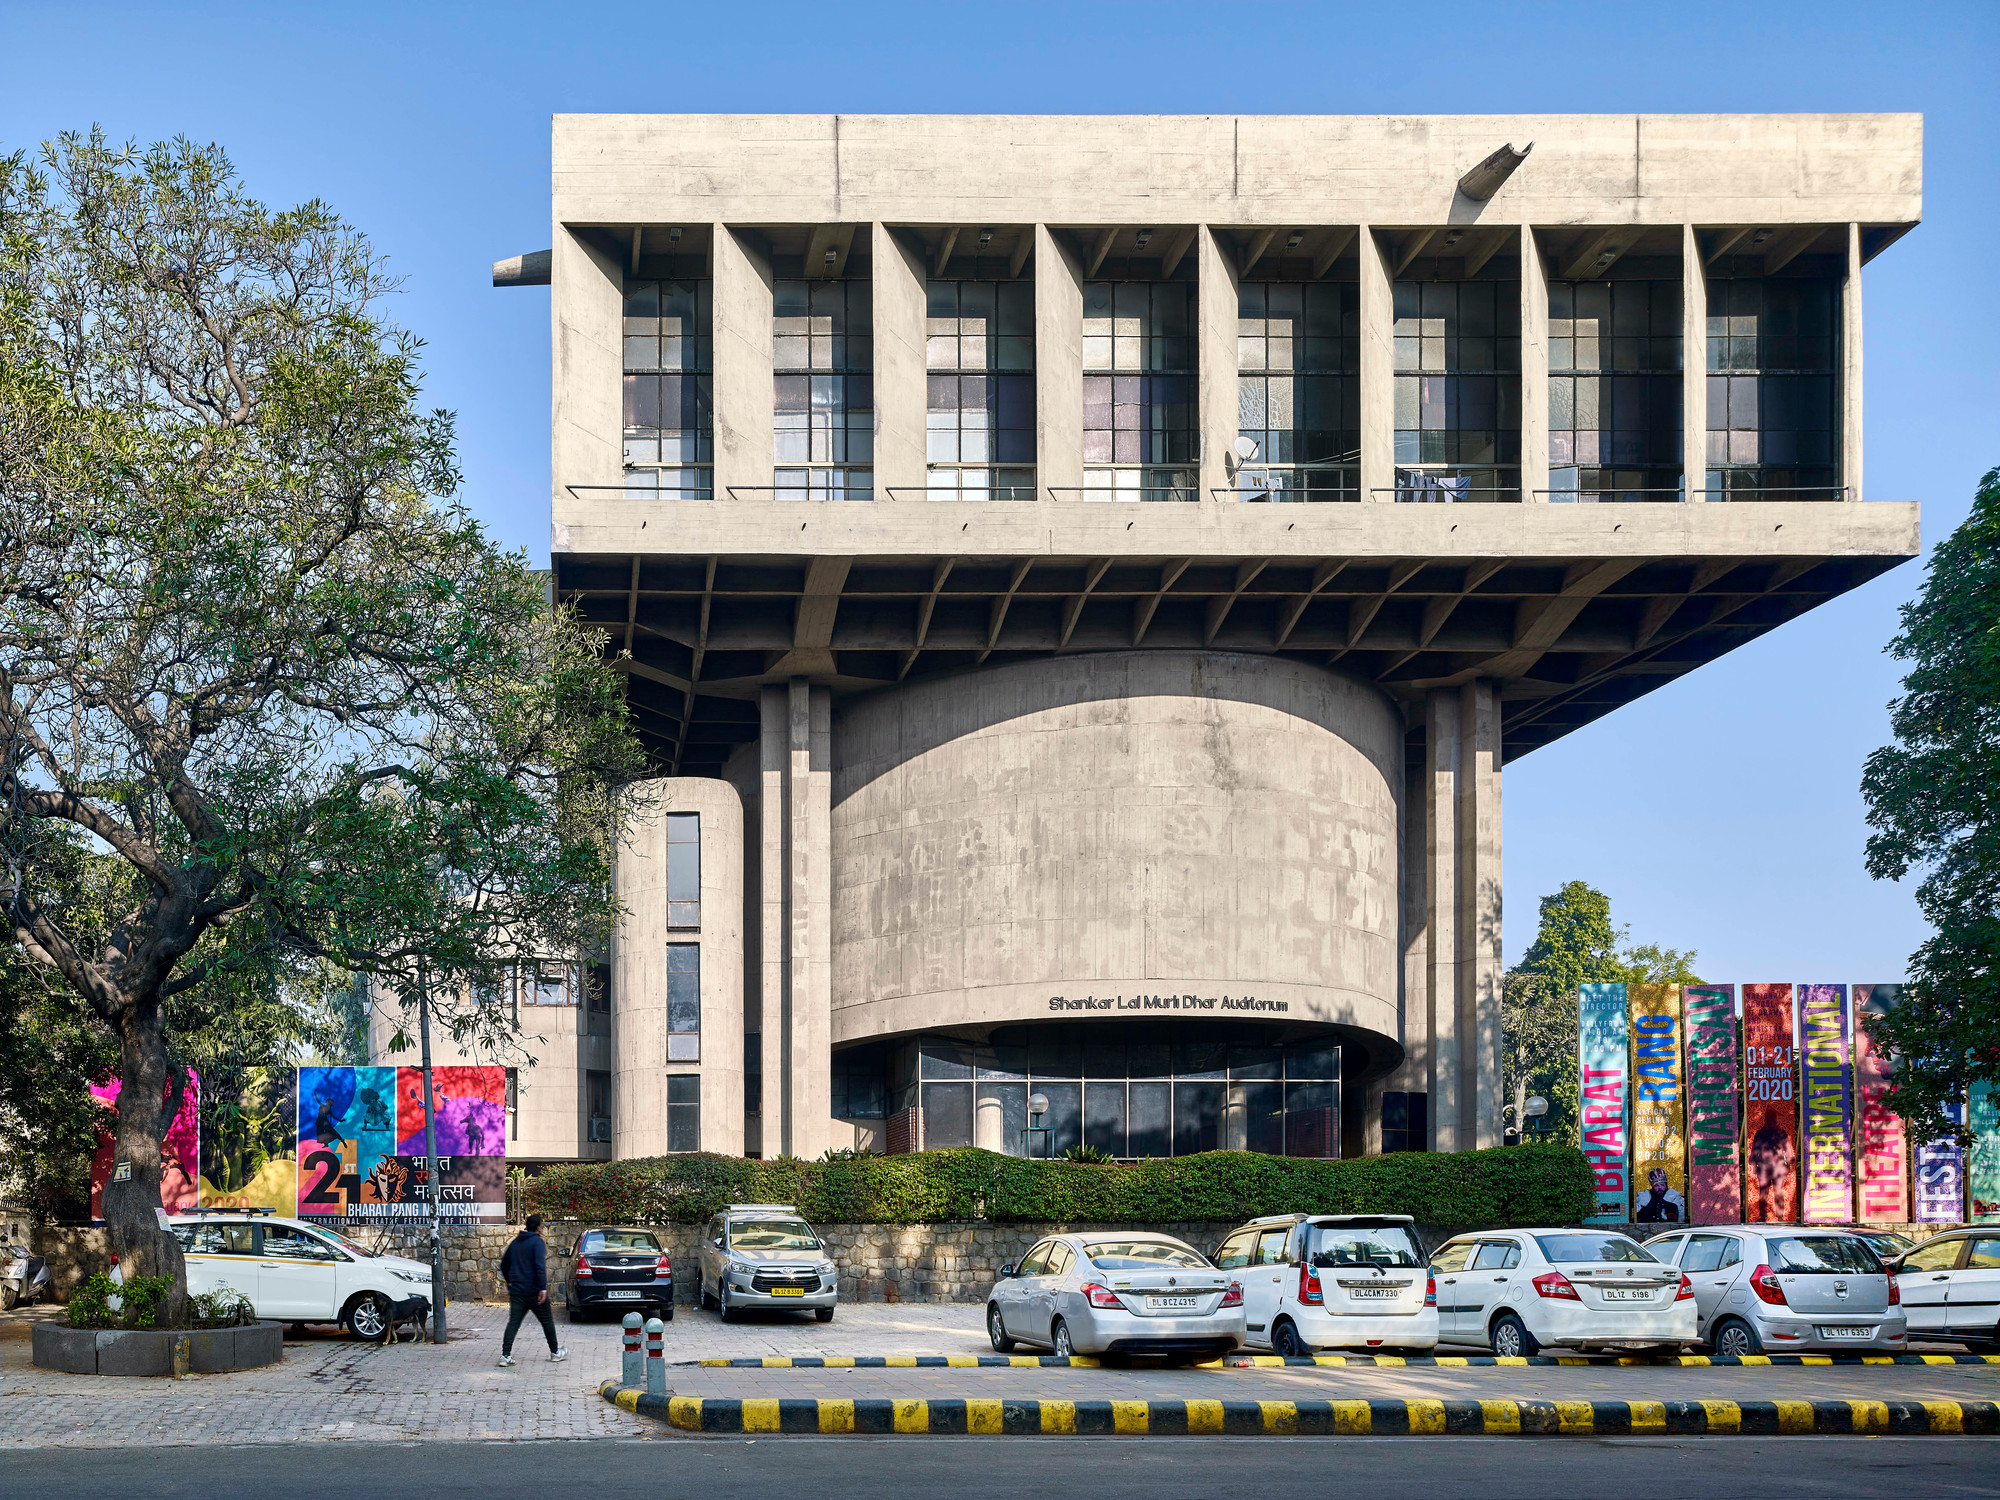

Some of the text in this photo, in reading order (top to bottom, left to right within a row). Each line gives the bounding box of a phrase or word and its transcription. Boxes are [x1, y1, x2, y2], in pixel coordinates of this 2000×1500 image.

[1049, 995, 1288, 1012] Shankar Lal Murli Dhar Auditorium
[1581, 1002, 1623, 1010] DIRECTOR
[1612, 1027, 1625, 1035] AM
[1636, 1015, 1677, 1101] RANG
[1747, 1046, 1791, 1065] 01-21
[1689, 988, 1734, 1165] MAHOTSAV
[1748, 1066, 1792, 1078] FEBRUARY
[1748, 1079, 1793, 1101] 2020
[1806, 992, 1845, 1218] INTERNATIONAL
[1584, 1064, 1624, 1191] BHARAT
[348, 1203, 478, 1217] BHARAT RANG MHOTSAV
[445, 1217, 454, 1225] OF
[459, 1217, 481, 1225] INDIA
